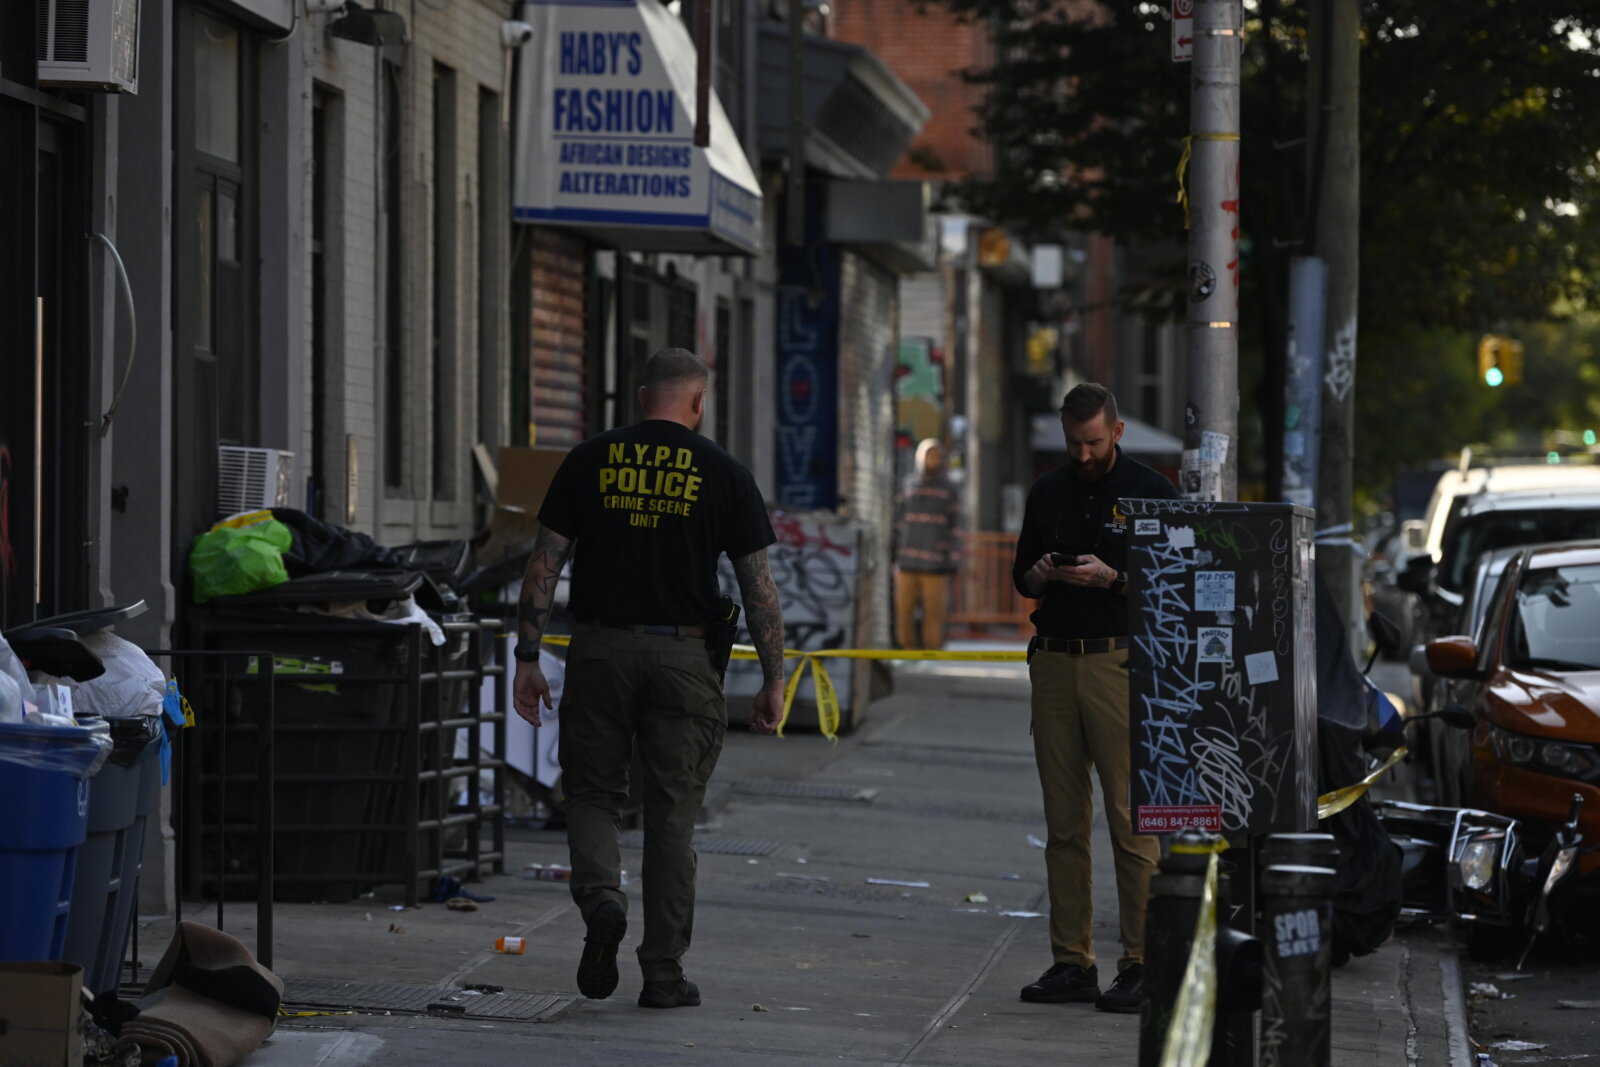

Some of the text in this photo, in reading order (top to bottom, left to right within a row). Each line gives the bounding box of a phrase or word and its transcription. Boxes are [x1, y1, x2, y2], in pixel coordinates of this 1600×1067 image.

[560, 32, 642, 76] HABY'S
[553, 88, 675, 133] FASHION
[559, 142, 692, 168] AFRICAN DESIGNS
[559, 172, 691, 198] ALTERATIONS
[608, 442, 698, 472] N.Y.P.D.
[599, 467, 702, 501] POLICE
[603, 495, 691, 516] CRIME SCENE
[630, 513, 660, 528] UNIT
[1201, 630, 1229, 639] PROTECT
[1141, 816, 1217, 829] (646) 847-8861
